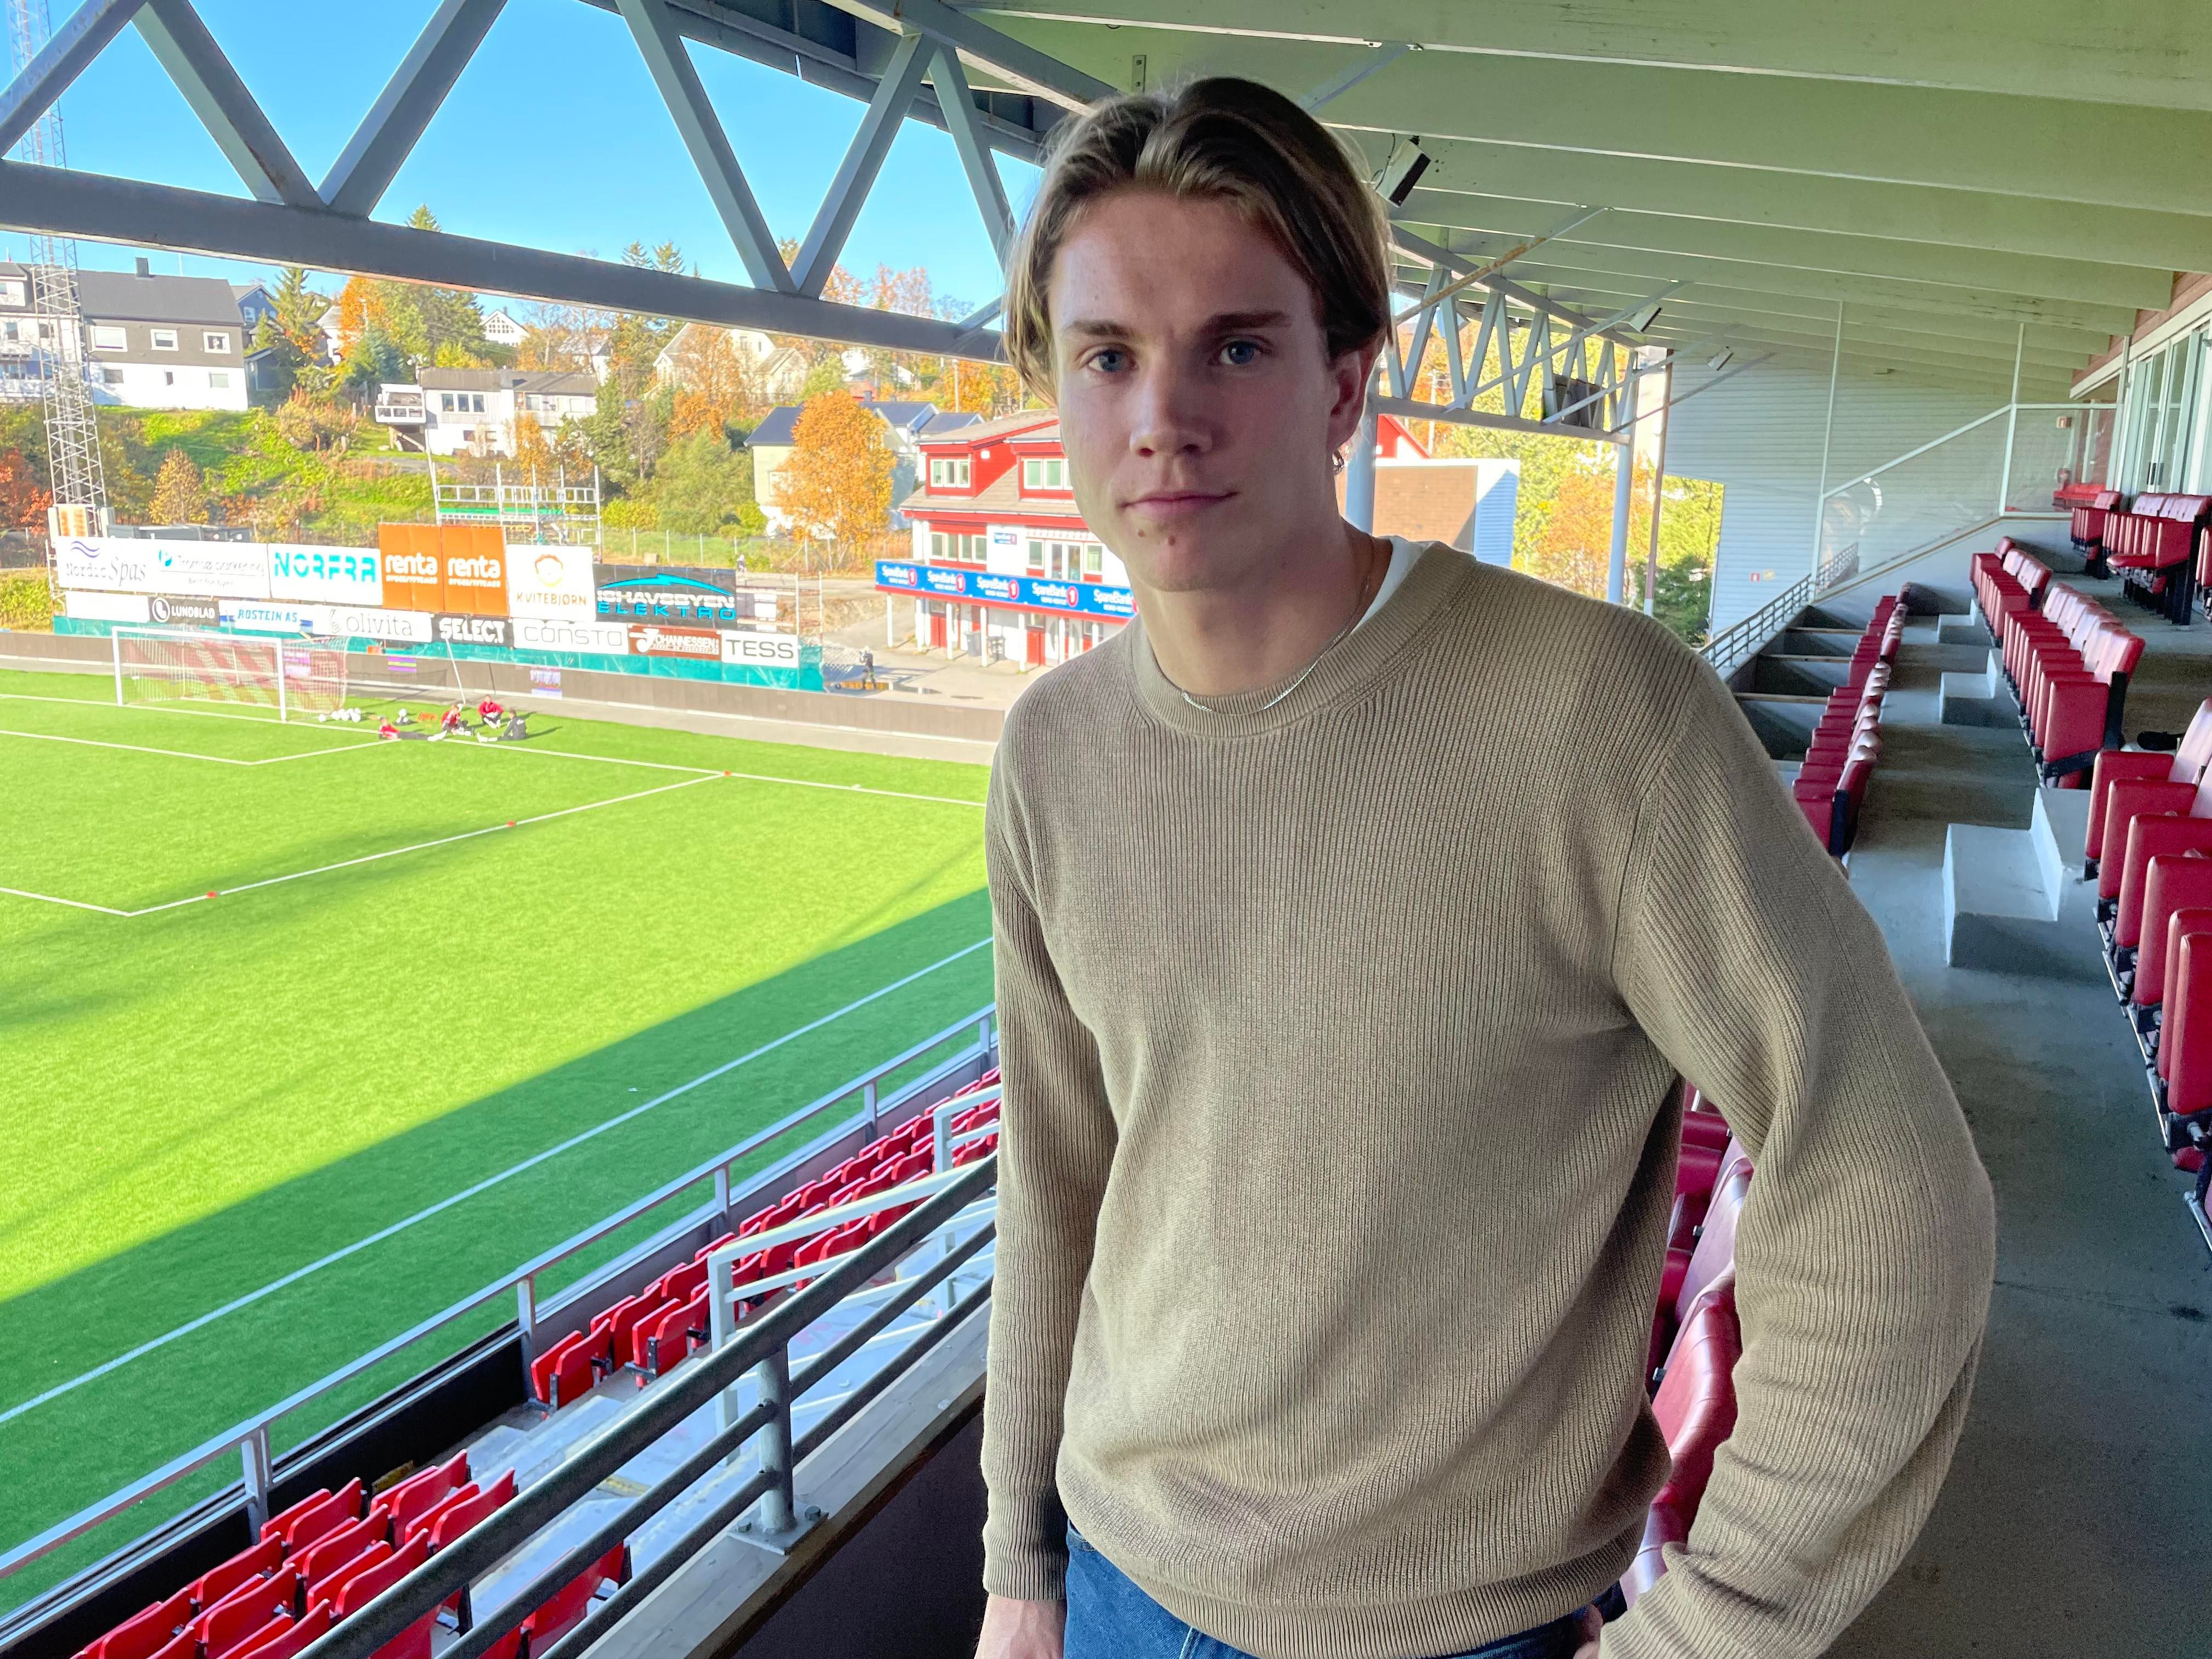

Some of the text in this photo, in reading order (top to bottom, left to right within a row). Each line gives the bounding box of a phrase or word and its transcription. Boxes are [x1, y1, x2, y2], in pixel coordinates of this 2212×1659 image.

[66, 557, 146, 586] Nordic Spas
[386, 552, 438, 575] renta
[448, 555, 501, 578] renta
[517, 592, 586, 606] KVITEBJØRN
[597, 590, 735, 607] ISHAVSBYEN
[171, 605, 215, 619] LUNDBLAD
[238, 609, 298, 622] ROSTEIN AS
[597, 601, 736, 620] ELEKTRO
[346, 613, 413, 636] olivita
[439, 617, 505, 644] SELECT
[629, 628, 715, 652] JOHANNESSEN
[725, 639, 794, 659] TESS
